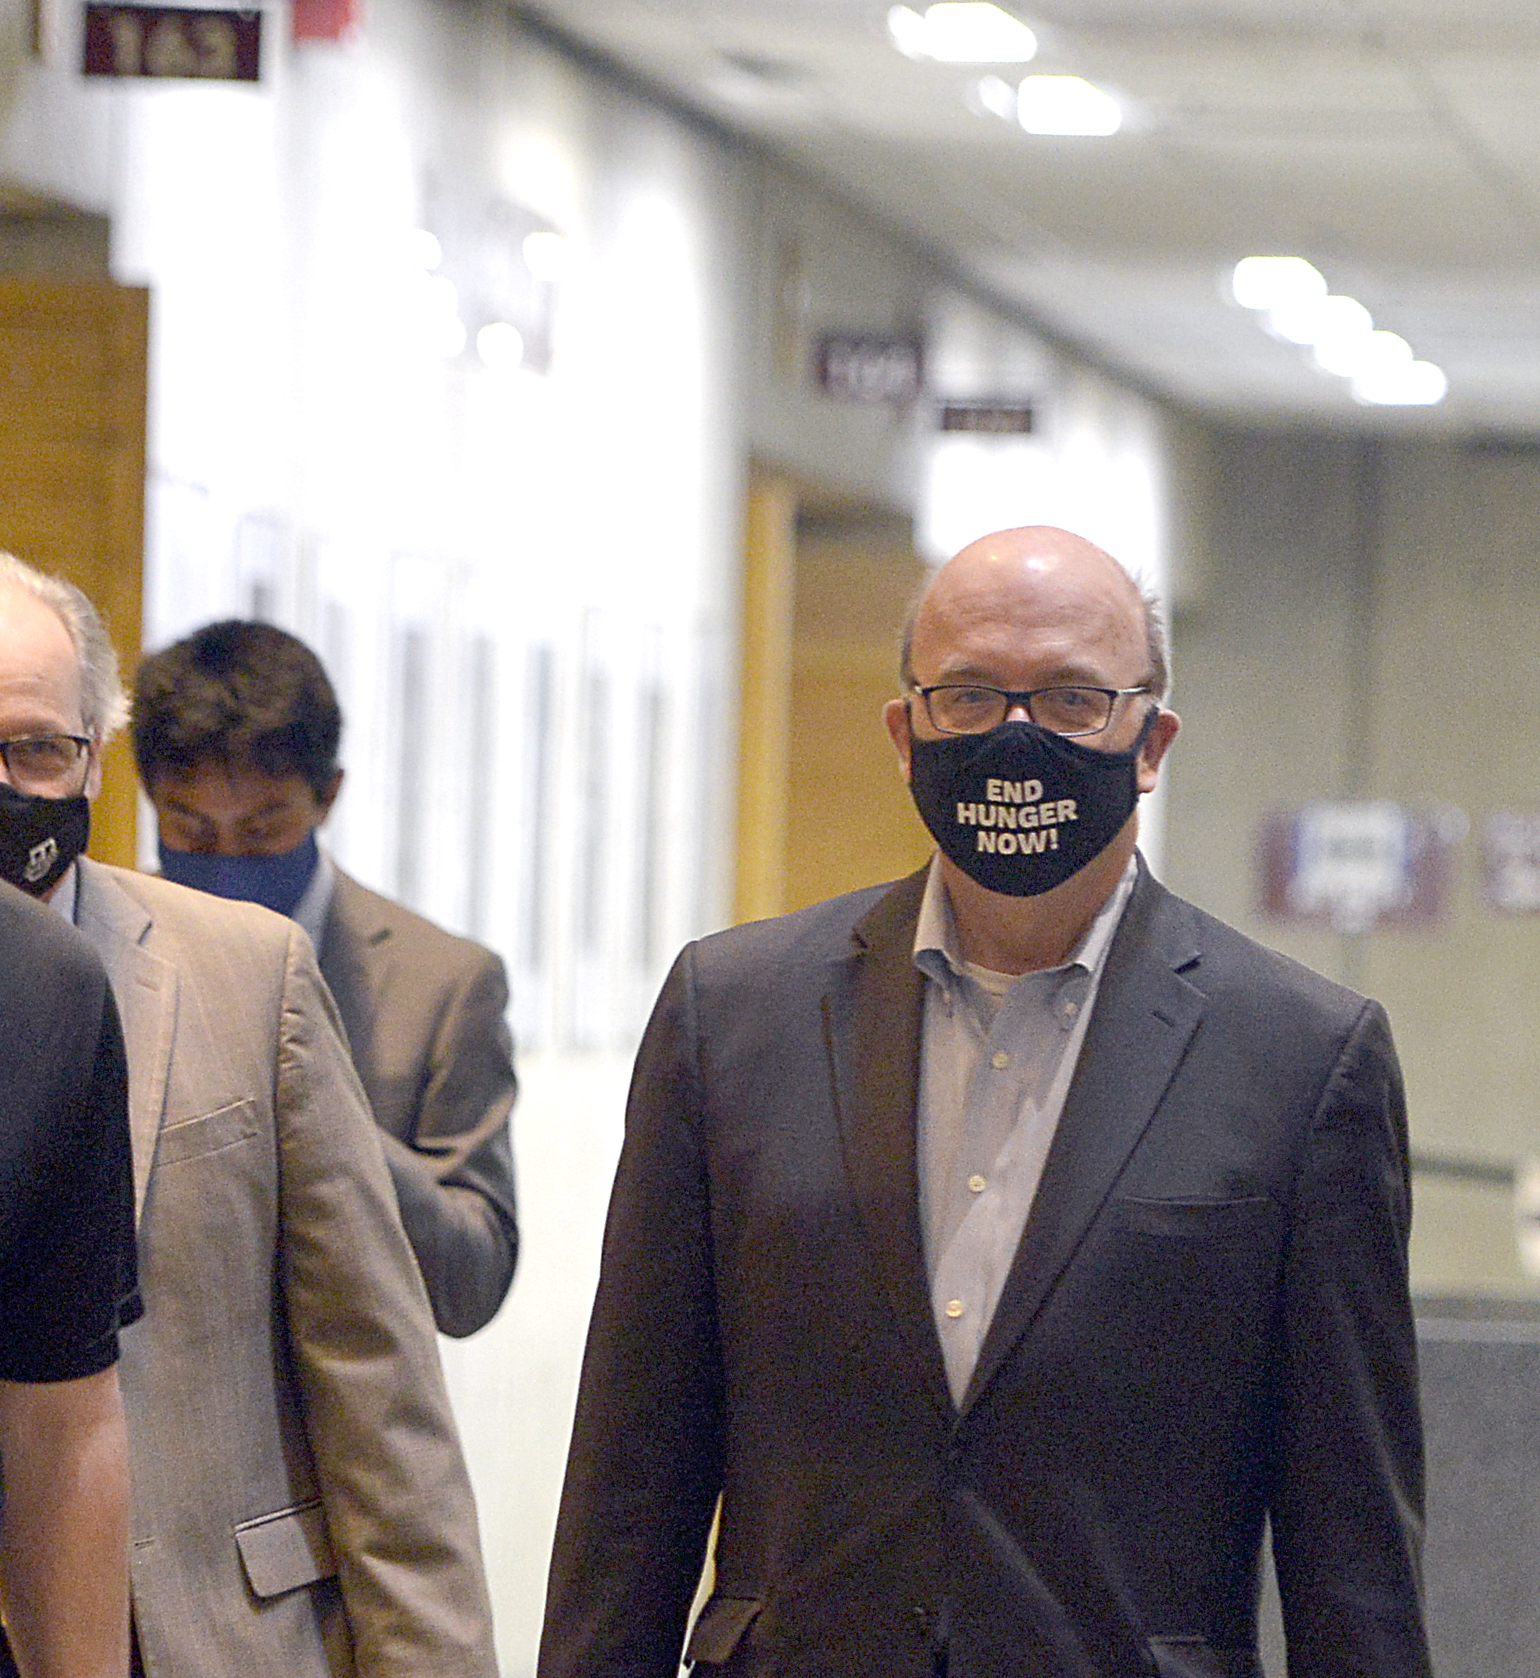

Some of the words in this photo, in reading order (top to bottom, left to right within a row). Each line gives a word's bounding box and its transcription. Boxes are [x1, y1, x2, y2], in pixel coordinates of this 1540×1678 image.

[986, 778, 1044, 803] END
[956, 799, 1079, 828] HUNGER
[977, 829, 1059, 855] NOW!
